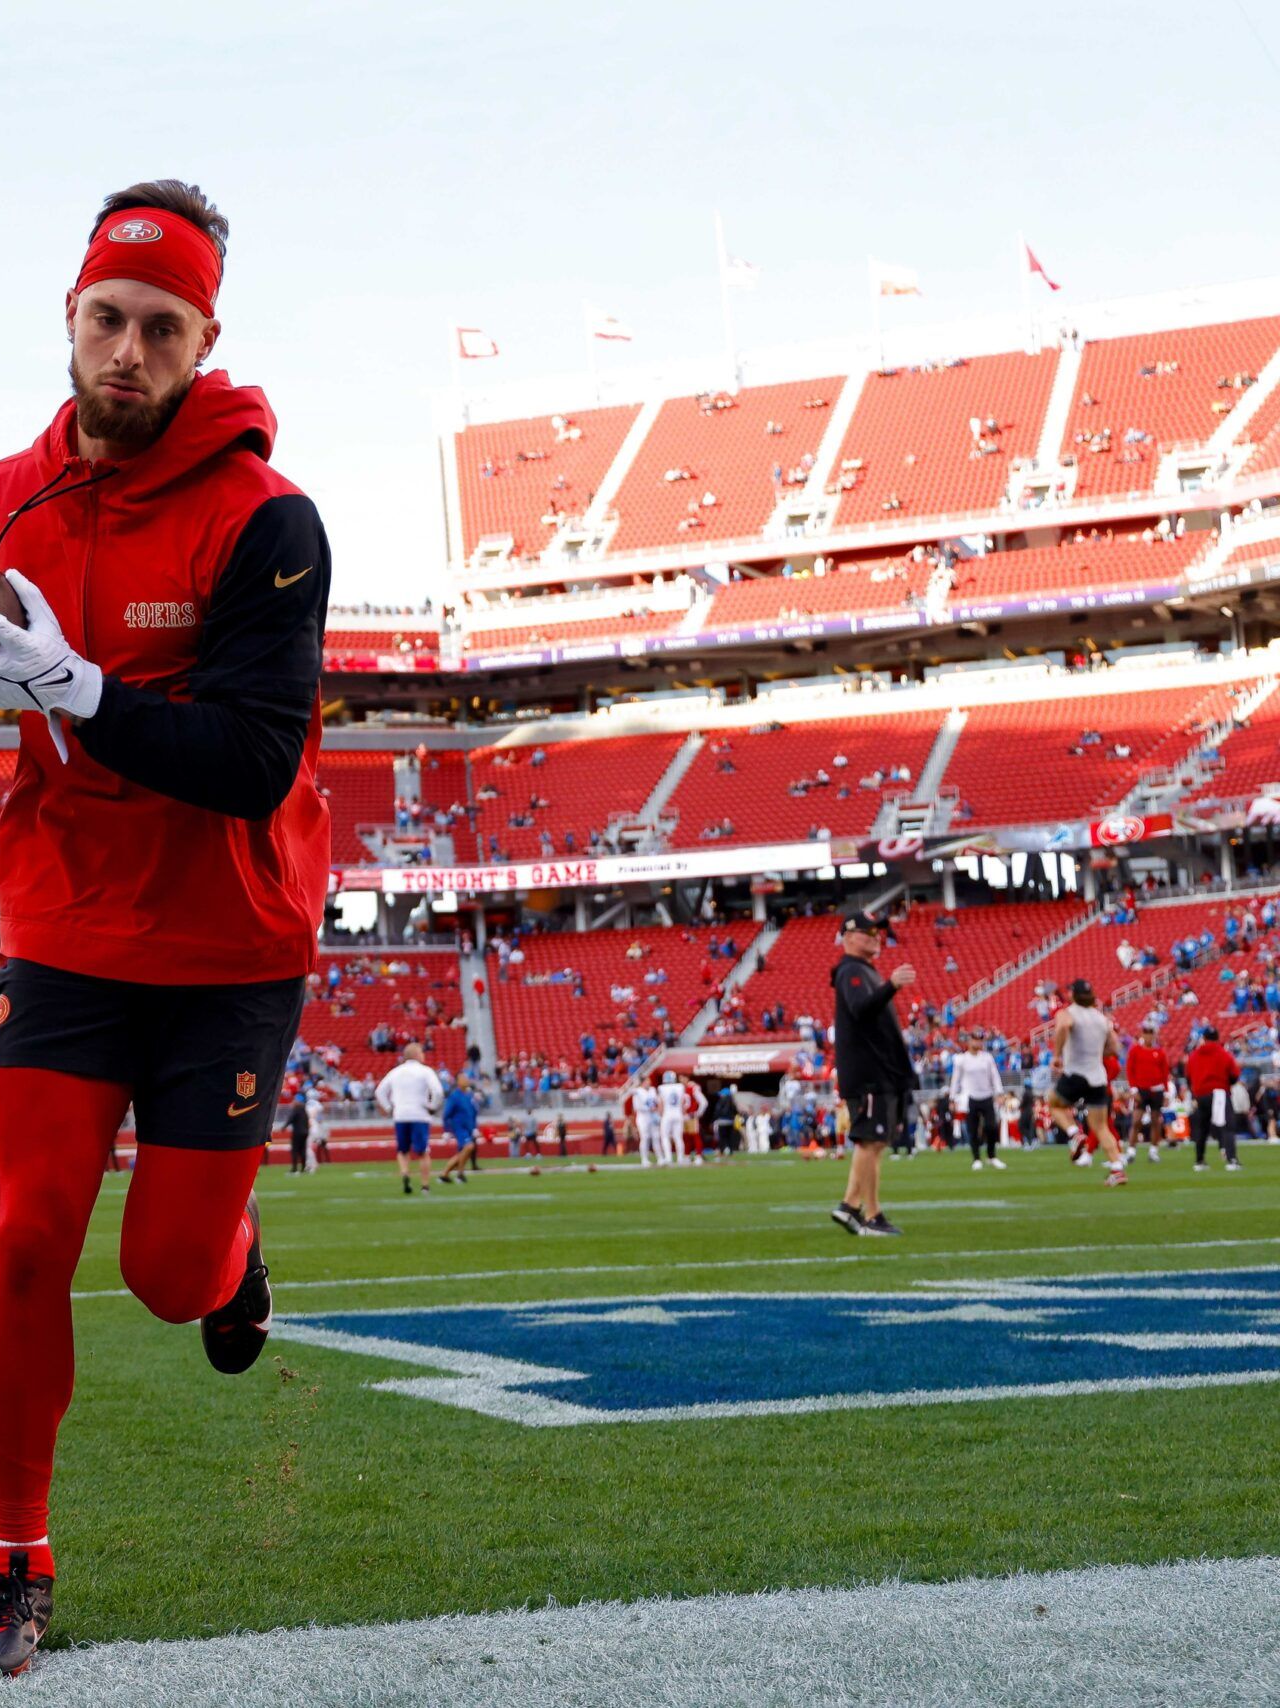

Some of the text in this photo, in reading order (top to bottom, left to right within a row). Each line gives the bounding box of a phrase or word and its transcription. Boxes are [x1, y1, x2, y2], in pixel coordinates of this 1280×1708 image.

[123, 602, 196, 628] 49ERS
[402, 869, 517, 891] TONIGHT'S
[531, 863, 598, 885] GAME
[618, 863, 671, 873] Presented
